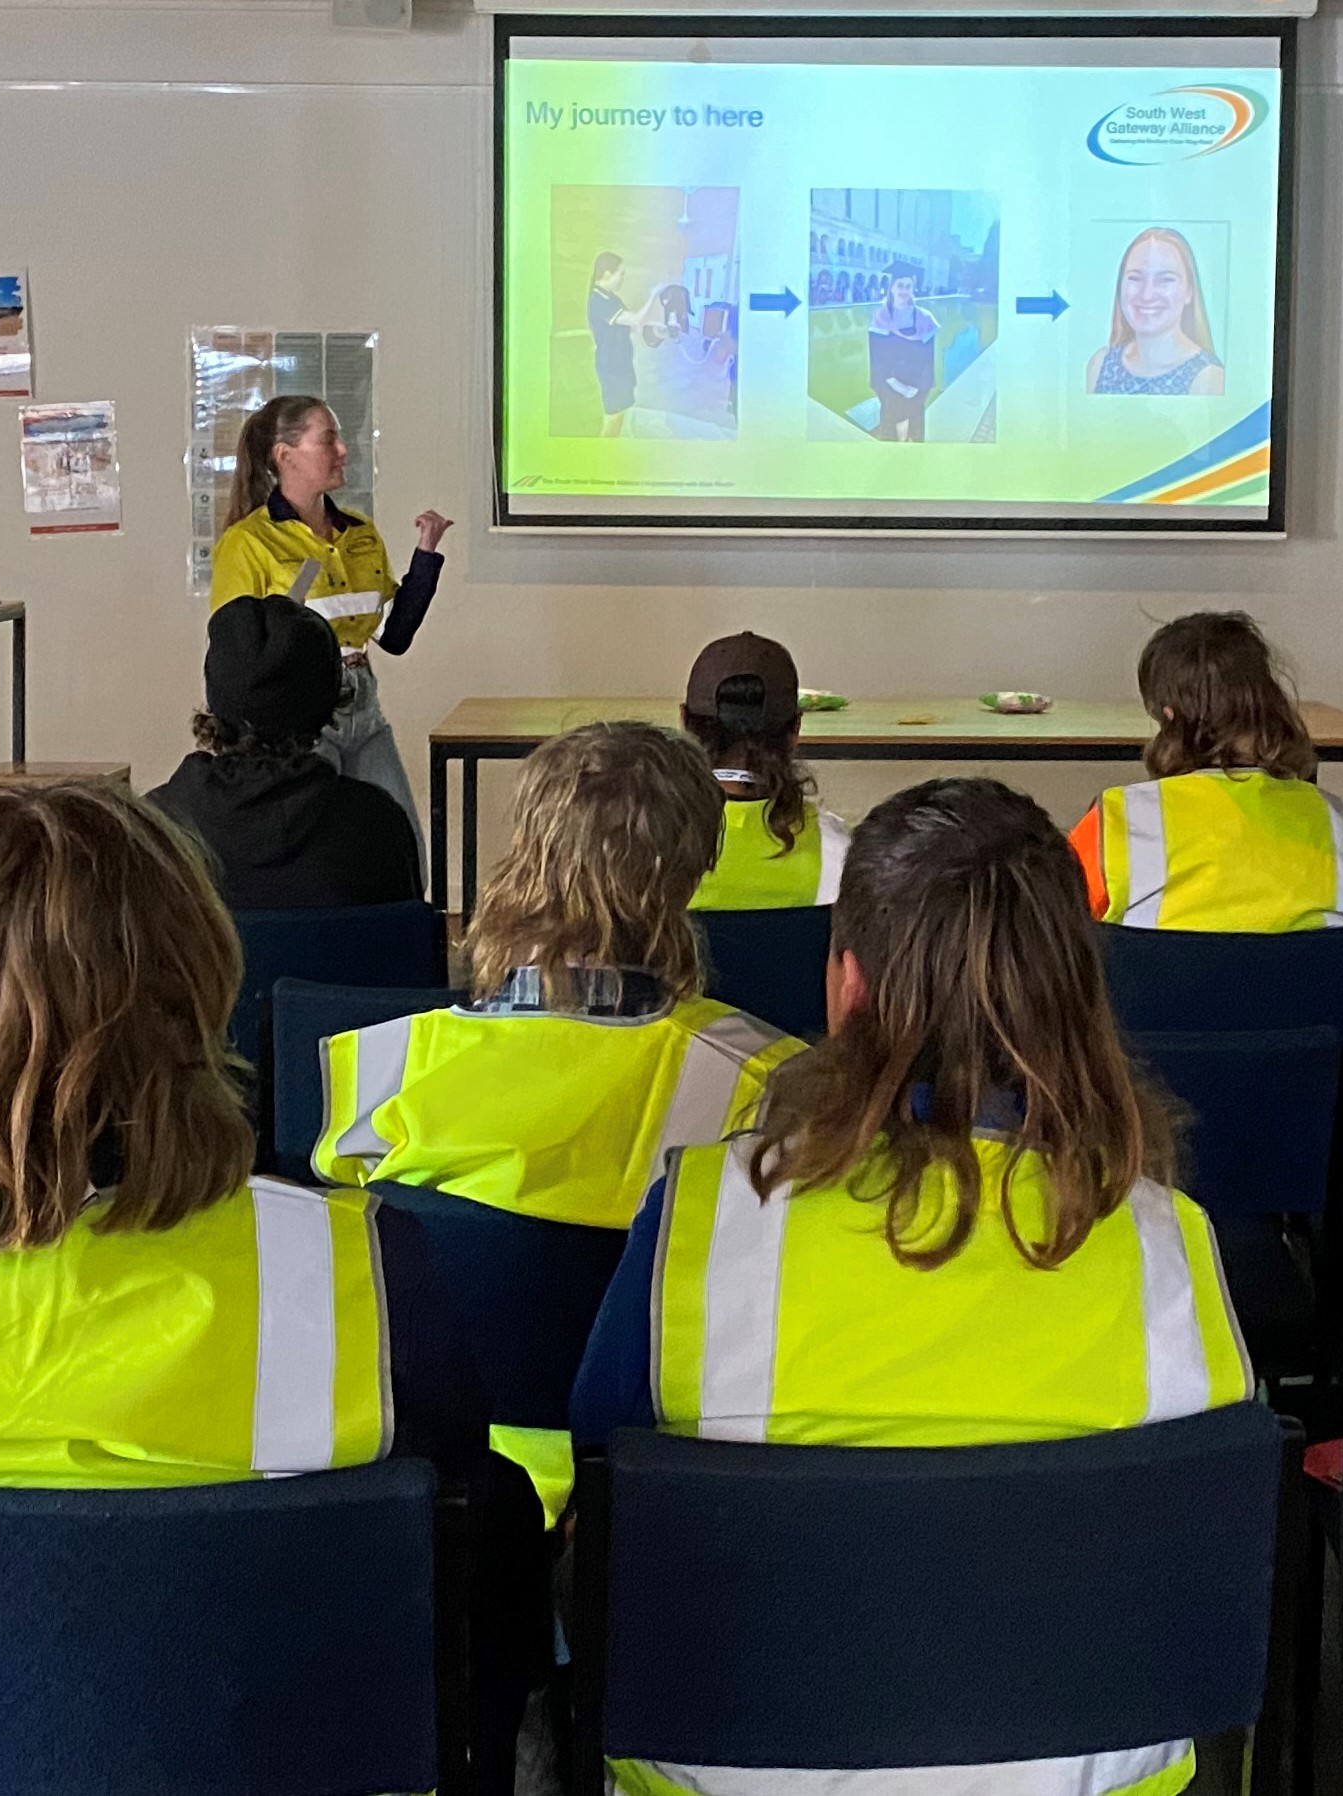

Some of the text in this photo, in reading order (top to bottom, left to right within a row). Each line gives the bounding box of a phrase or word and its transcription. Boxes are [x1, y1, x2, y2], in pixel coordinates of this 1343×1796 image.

[526, 101, 764, 132] My journey to here
[1126, 106, 1206, 120] South West
[1106, 121, 1226, 137] Gateway Alliance
